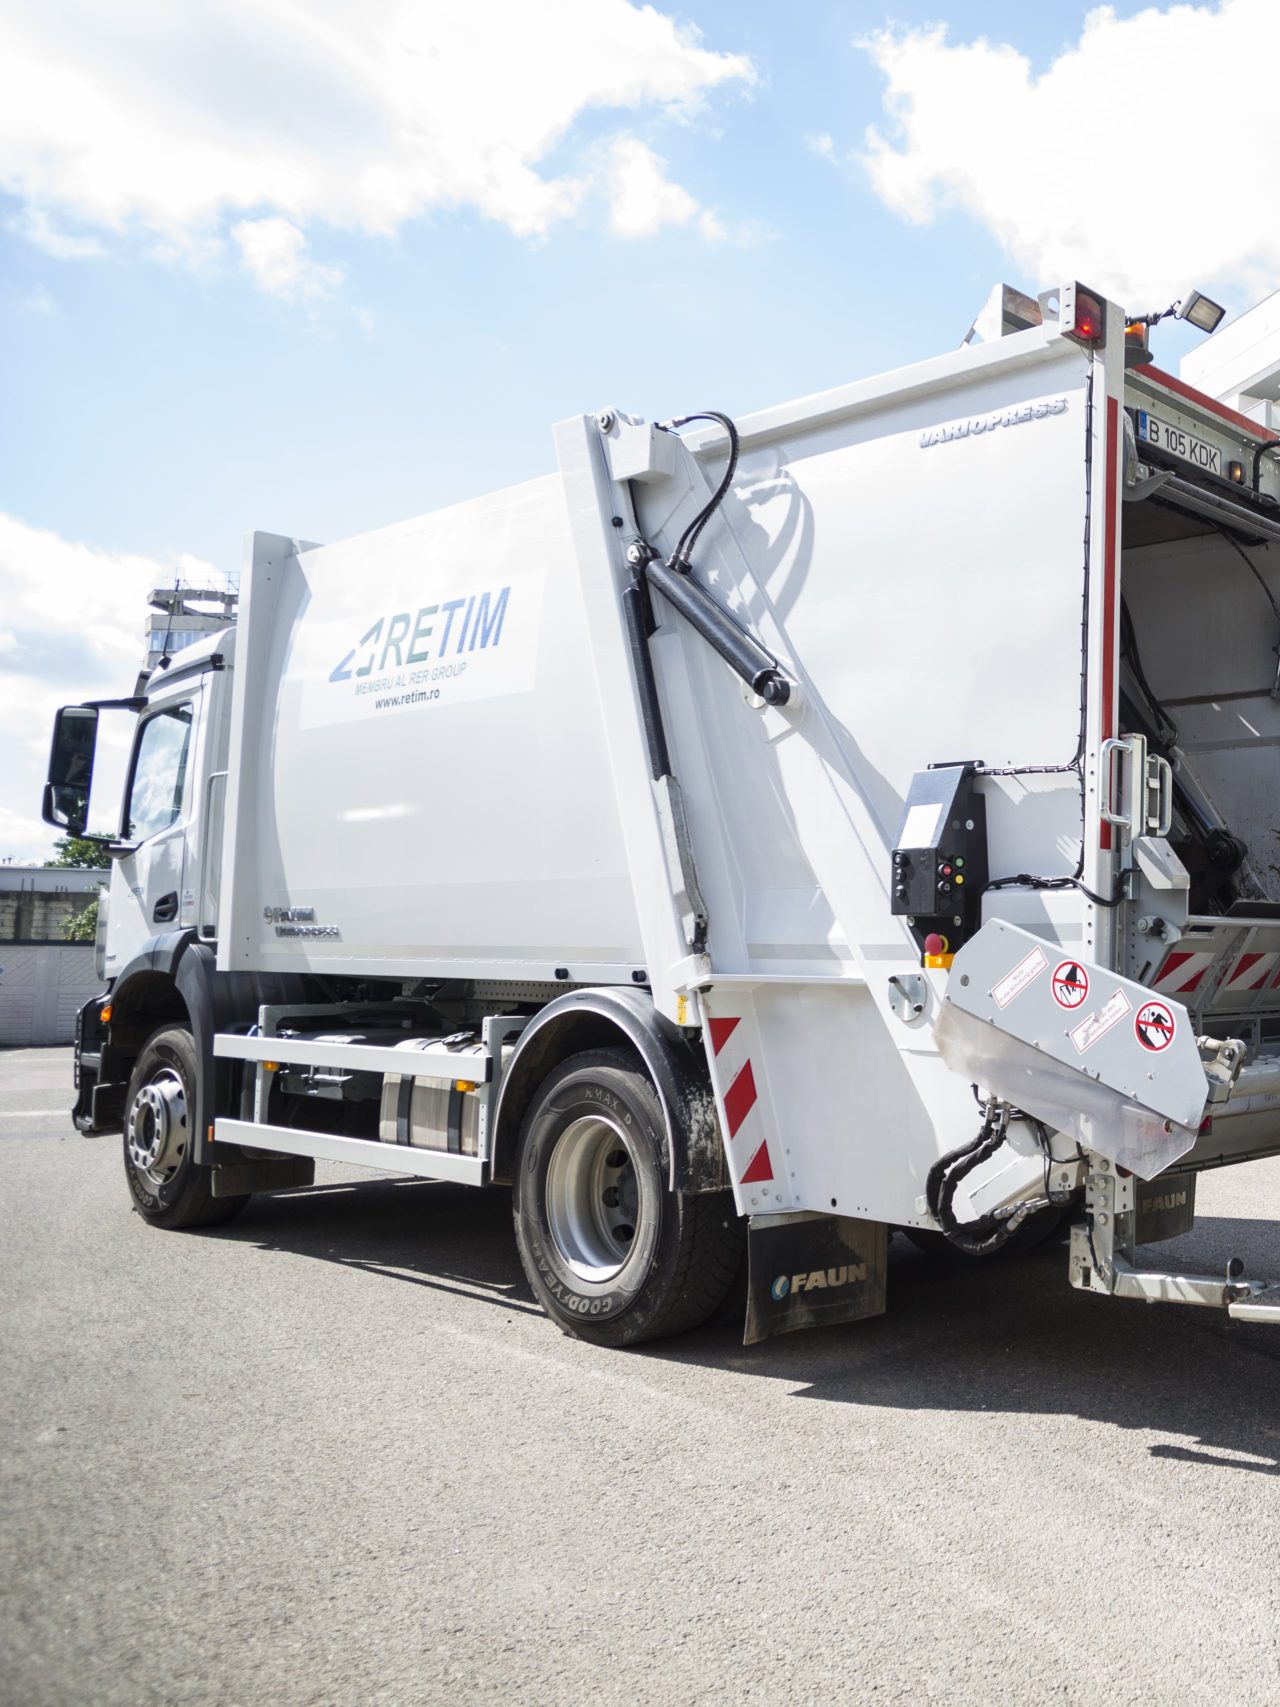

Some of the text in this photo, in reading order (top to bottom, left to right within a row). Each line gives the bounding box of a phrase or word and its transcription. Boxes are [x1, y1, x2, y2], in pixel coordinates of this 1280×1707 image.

[919, 398, 1069, 448] VARIOPRESS
[1149, 420, 1217, 473] B 105 KDK
[379, 586, 511, 670] RETIM
[354, 662, 467, 696] MEMBRU AL RER GROUP
[375, 688, 440, 710] www.retim.ro
[585, 1086, 620, 1110] KMAX
[1142, 1191, 1186, 1213] FAUN
[790, 1262, 867, 1294] FAUN
